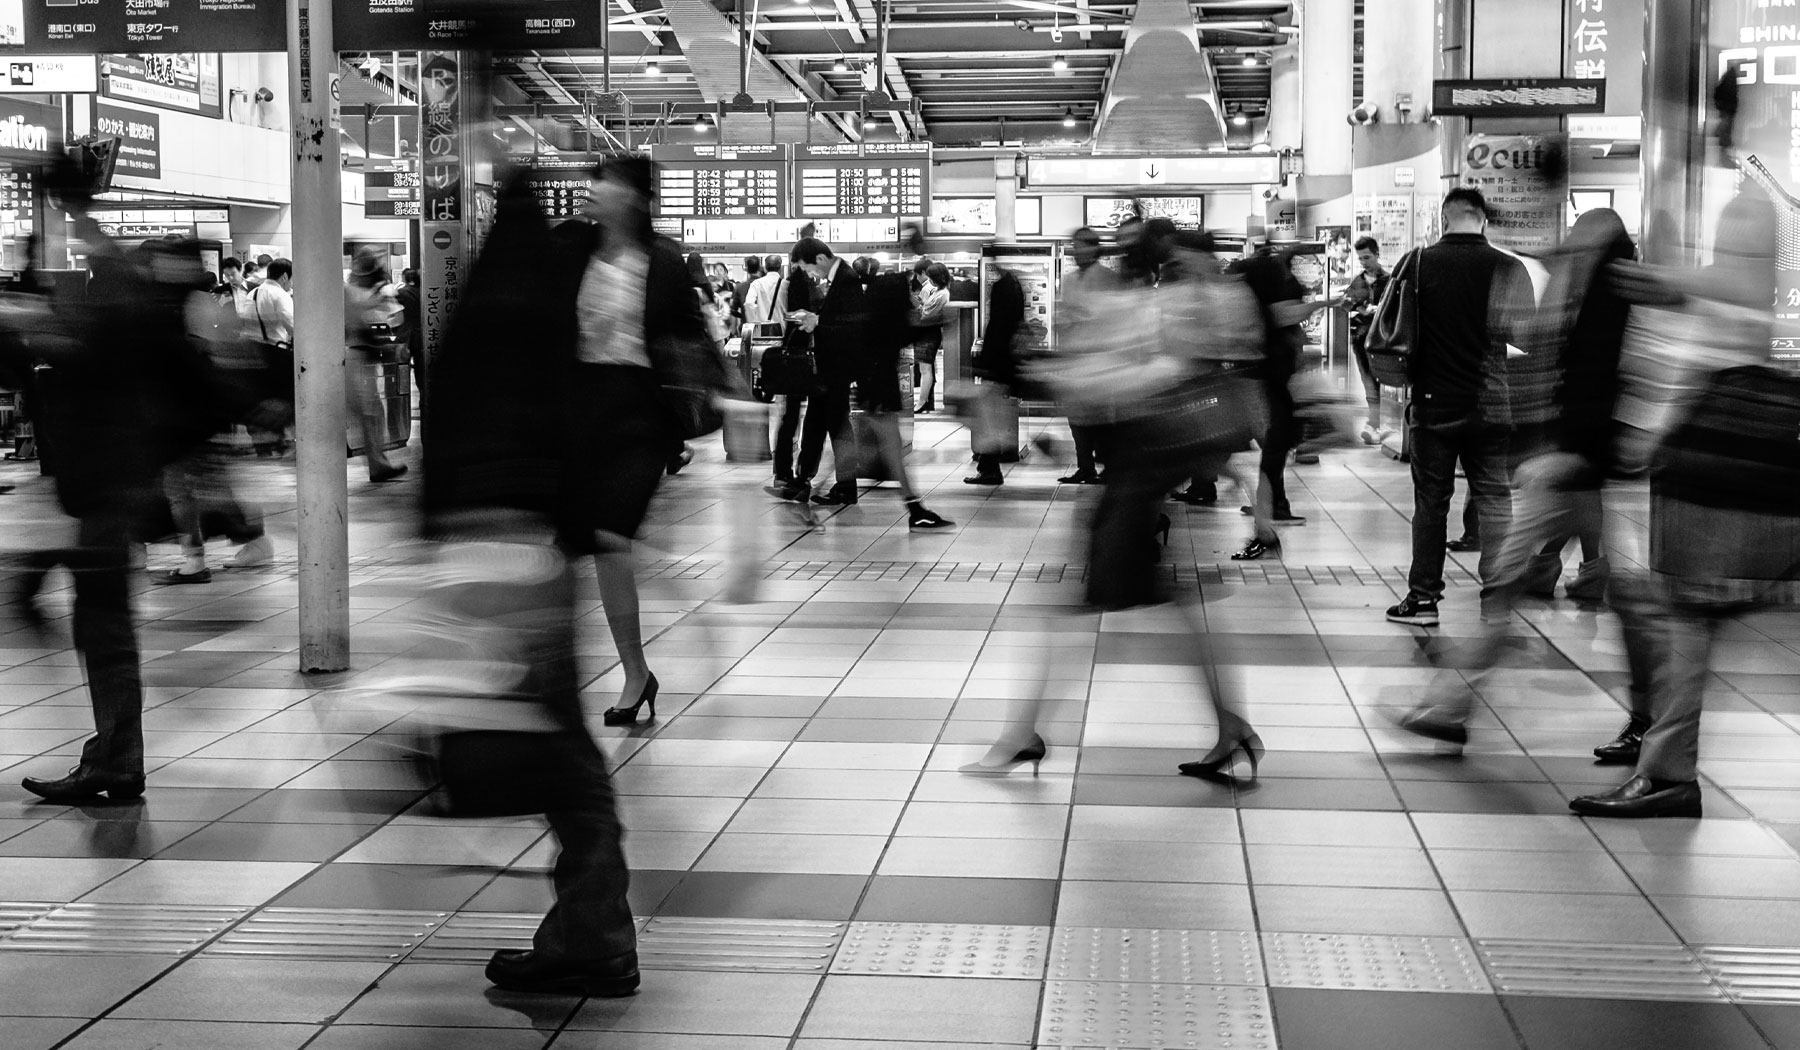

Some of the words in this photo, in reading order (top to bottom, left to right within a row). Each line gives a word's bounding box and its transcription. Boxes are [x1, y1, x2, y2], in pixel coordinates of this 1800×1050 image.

[127, 23, 178, 33] 東京タワー行
[1467, 144, 1544, 169] ecut
[697, 170, 720, 178] 20:42
[840, 168, 864, 177] 20:50
[697, 179, 720, 187] 20:52
[840, 177, 864, 186] 21:00
[697, 188, 720, 196] 20:59
[840, 186, 864, 195] 21:11
[697, 197, 720, 205] 21:02
[840, 195, 864, 204] 21:20
[840, 205, 864, 213] 21:30
